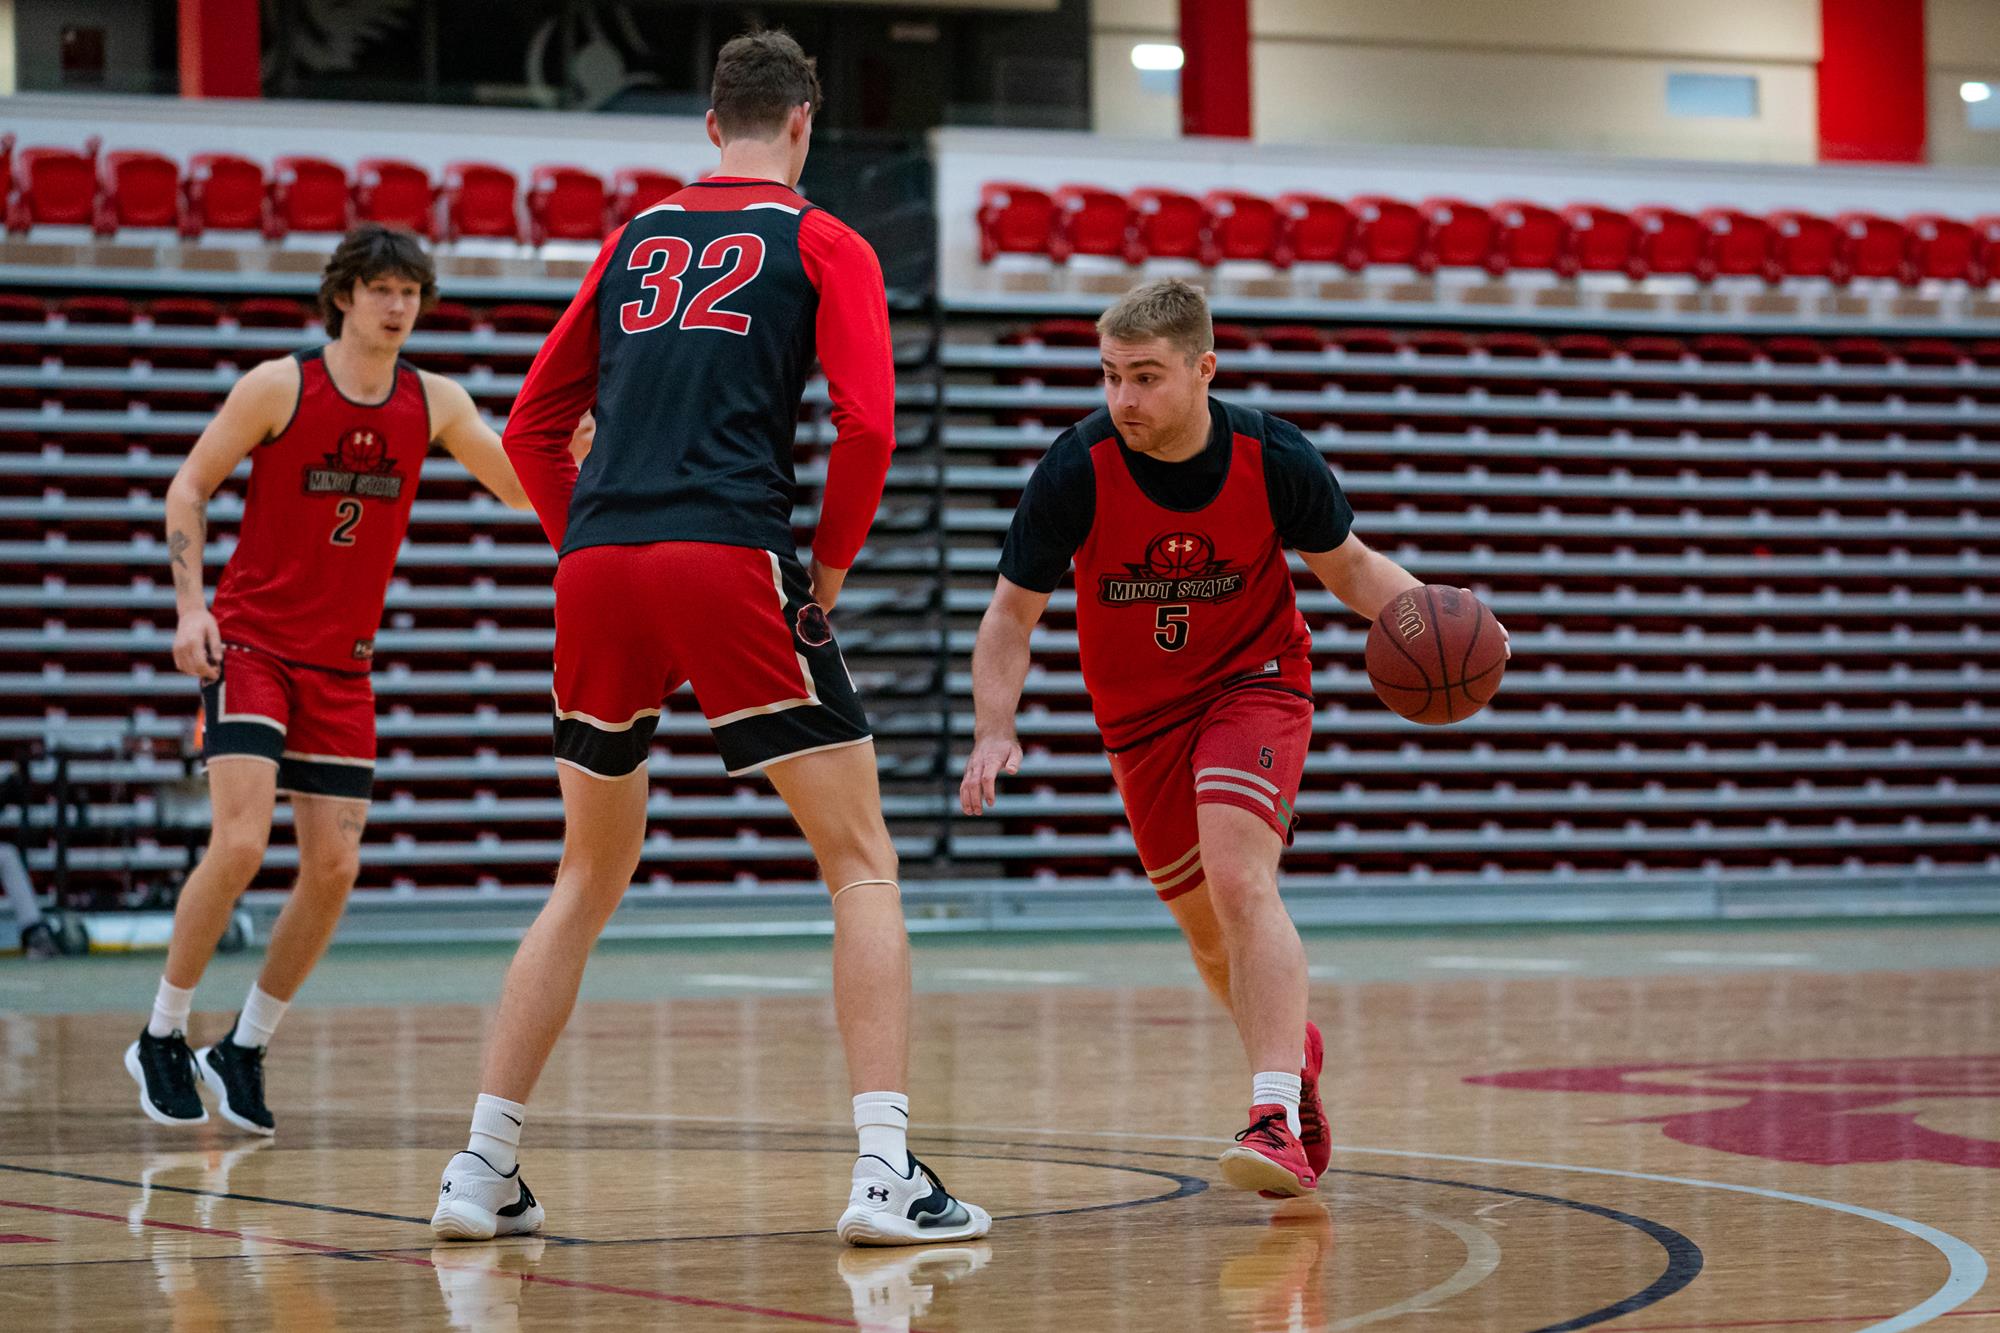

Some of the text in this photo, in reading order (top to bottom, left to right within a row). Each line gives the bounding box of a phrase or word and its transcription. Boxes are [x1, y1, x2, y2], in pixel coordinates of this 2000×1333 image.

[620, 232, 766, 336] 32
[329, 498, 364, 547] 2
[1109, 581, 1173, 601] MINOT
[1154, 604, 1190, 653] 5
[1258, 745, 1275, 770] 5
